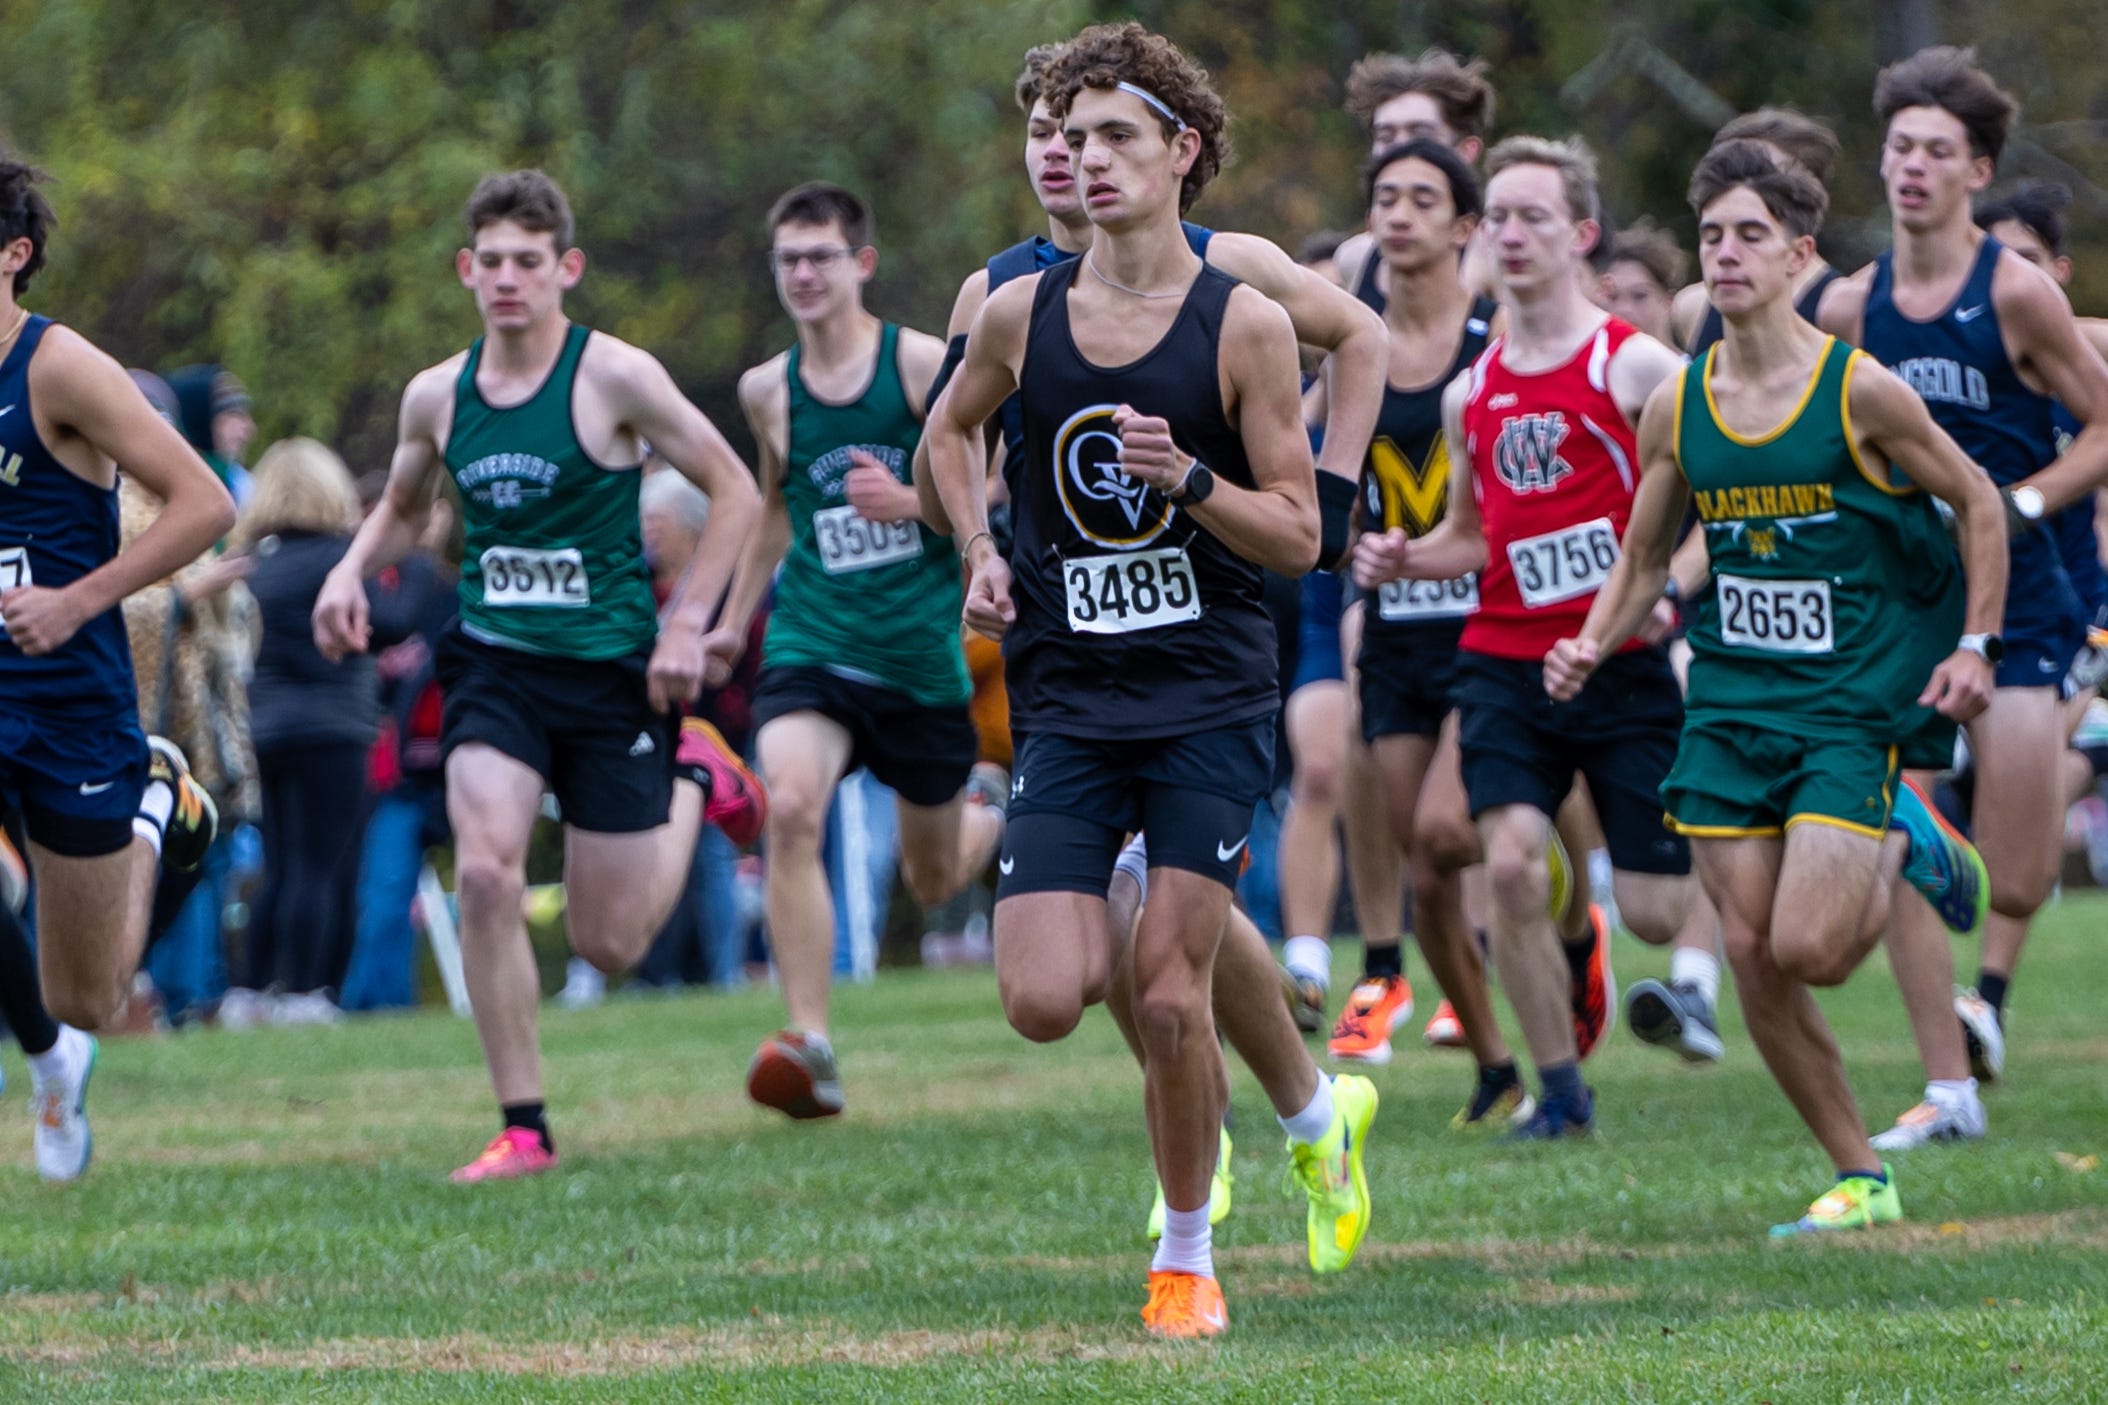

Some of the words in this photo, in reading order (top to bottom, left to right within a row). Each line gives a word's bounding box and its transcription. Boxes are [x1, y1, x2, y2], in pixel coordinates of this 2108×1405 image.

[456, 452, 560, 491] RIVERSIDE
[487, 556, 581, 593] 3512
[1516, 529, 1615, 592] 3756
[1069, 556, 1192, 623] 3485
[1724, 588, 1826, 642] 2653
